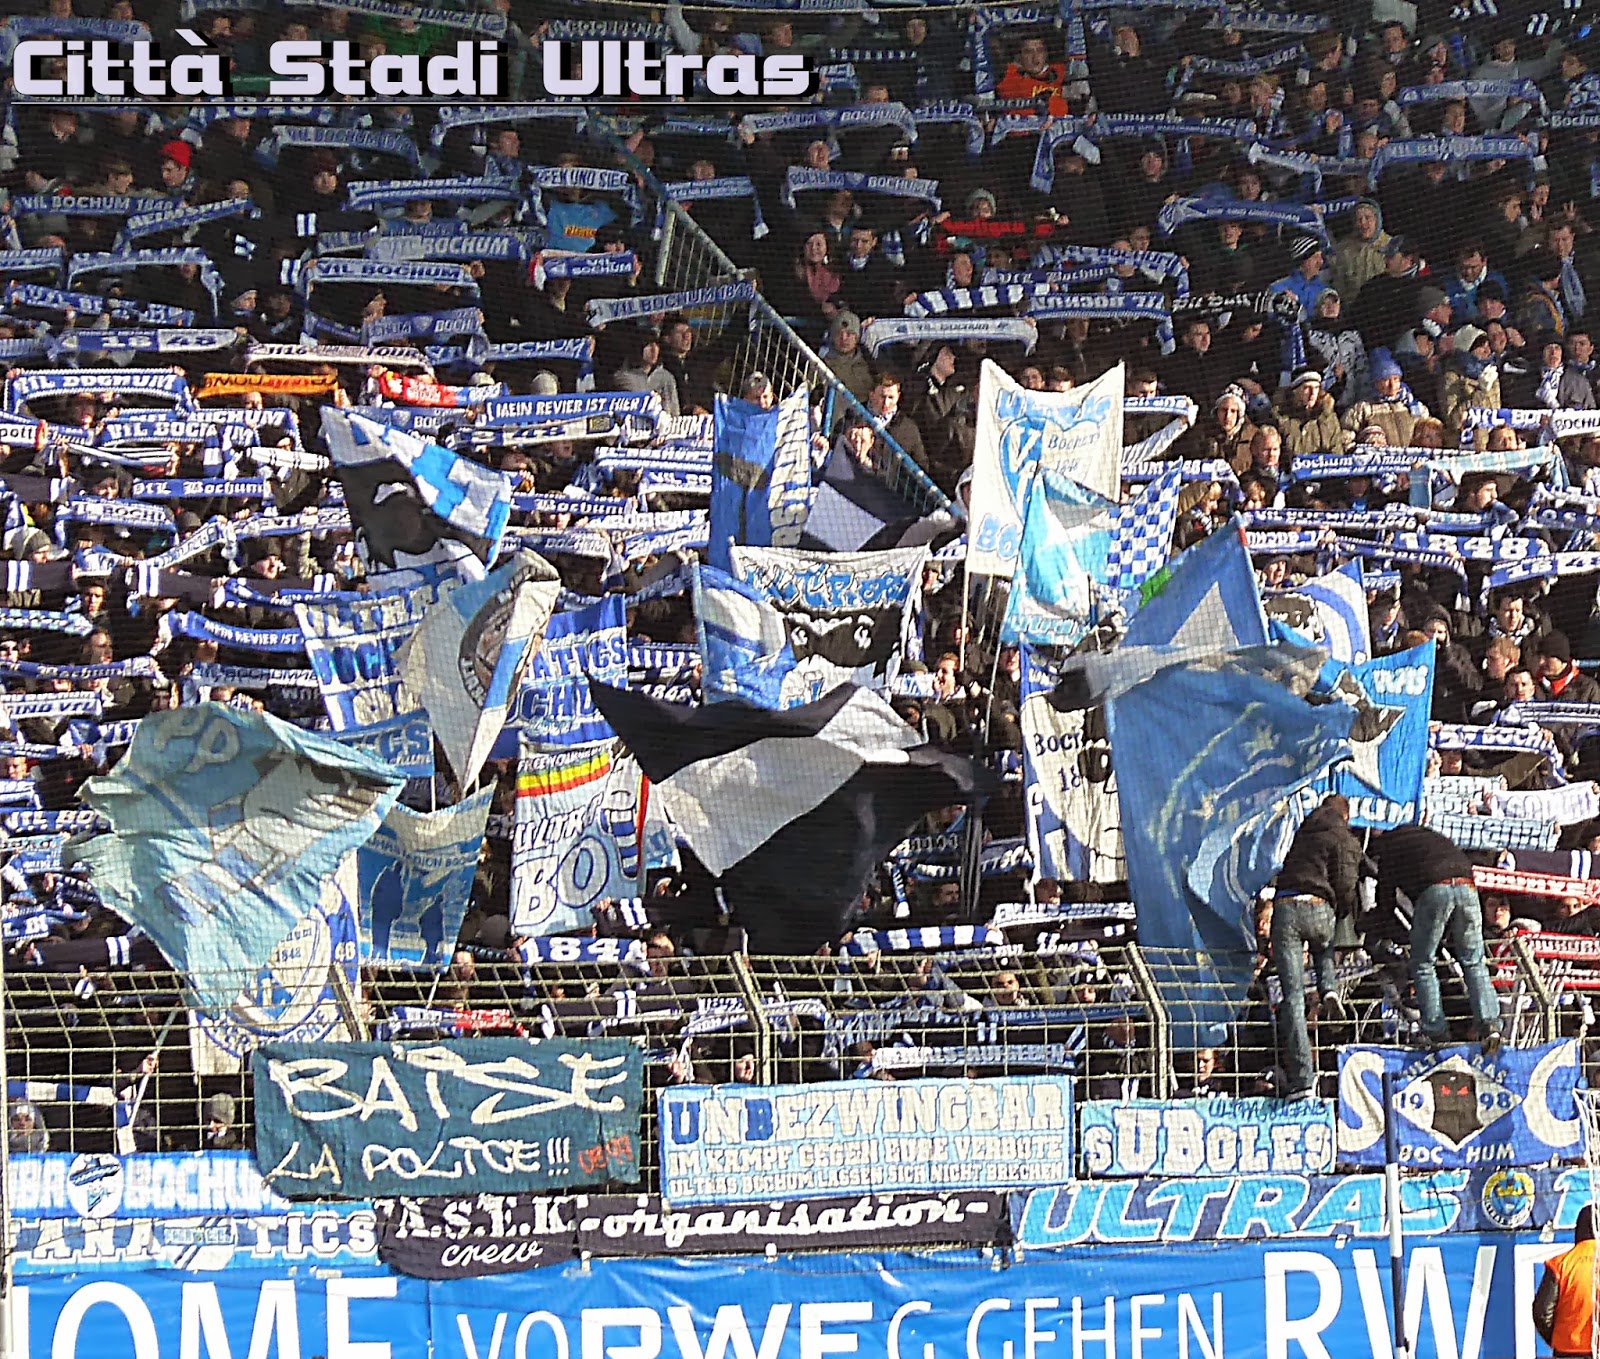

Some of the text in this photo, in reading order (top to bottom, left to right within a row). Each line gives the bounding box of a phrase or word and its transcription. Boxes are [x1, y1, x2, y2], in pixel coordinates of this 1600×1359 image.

[51, 195, 130, 209] BOCHUM
[424, 235, 510, 255] BOCHUM
[361, 262, 461, 278] BOCHUM
[639, 286, 716, 313] BOCHUM
[496, 402, 533, 419] MEIN
[535, 399, 583, 416] REVIER
[585, 397, 608, 412] IST
[1120, 460, 1164, 475] CHUM
[184, 480, 267, 496] Bochum
[1399, 532, 1531, 560] 1848
[281, 633, 299, 644] IST
[1057, 765, 1082, 793] 18
[512, 833, 610, 928] BO
[1400, 1091, 1513, 1110] 19 98
[668, 1083, 1066, 1146] UNBEZWINGBAR
[261, 1140, 343, 1189] LA
[361, 1135, 541, 1182] POLICE
[668, 1133, 1065, 1177] IM KAMPF GEGEN EURE VERBOTE
[1465, 1142, 1516, 1164] HUM
[668, 1160, 1065, 1199] ULTRAS BOCHUM LASSEN SICH NICHT BRECHEN
[1017, 1167, 1470, 1250] ULTRAS
[440, 1238, 544, 1267] crew
